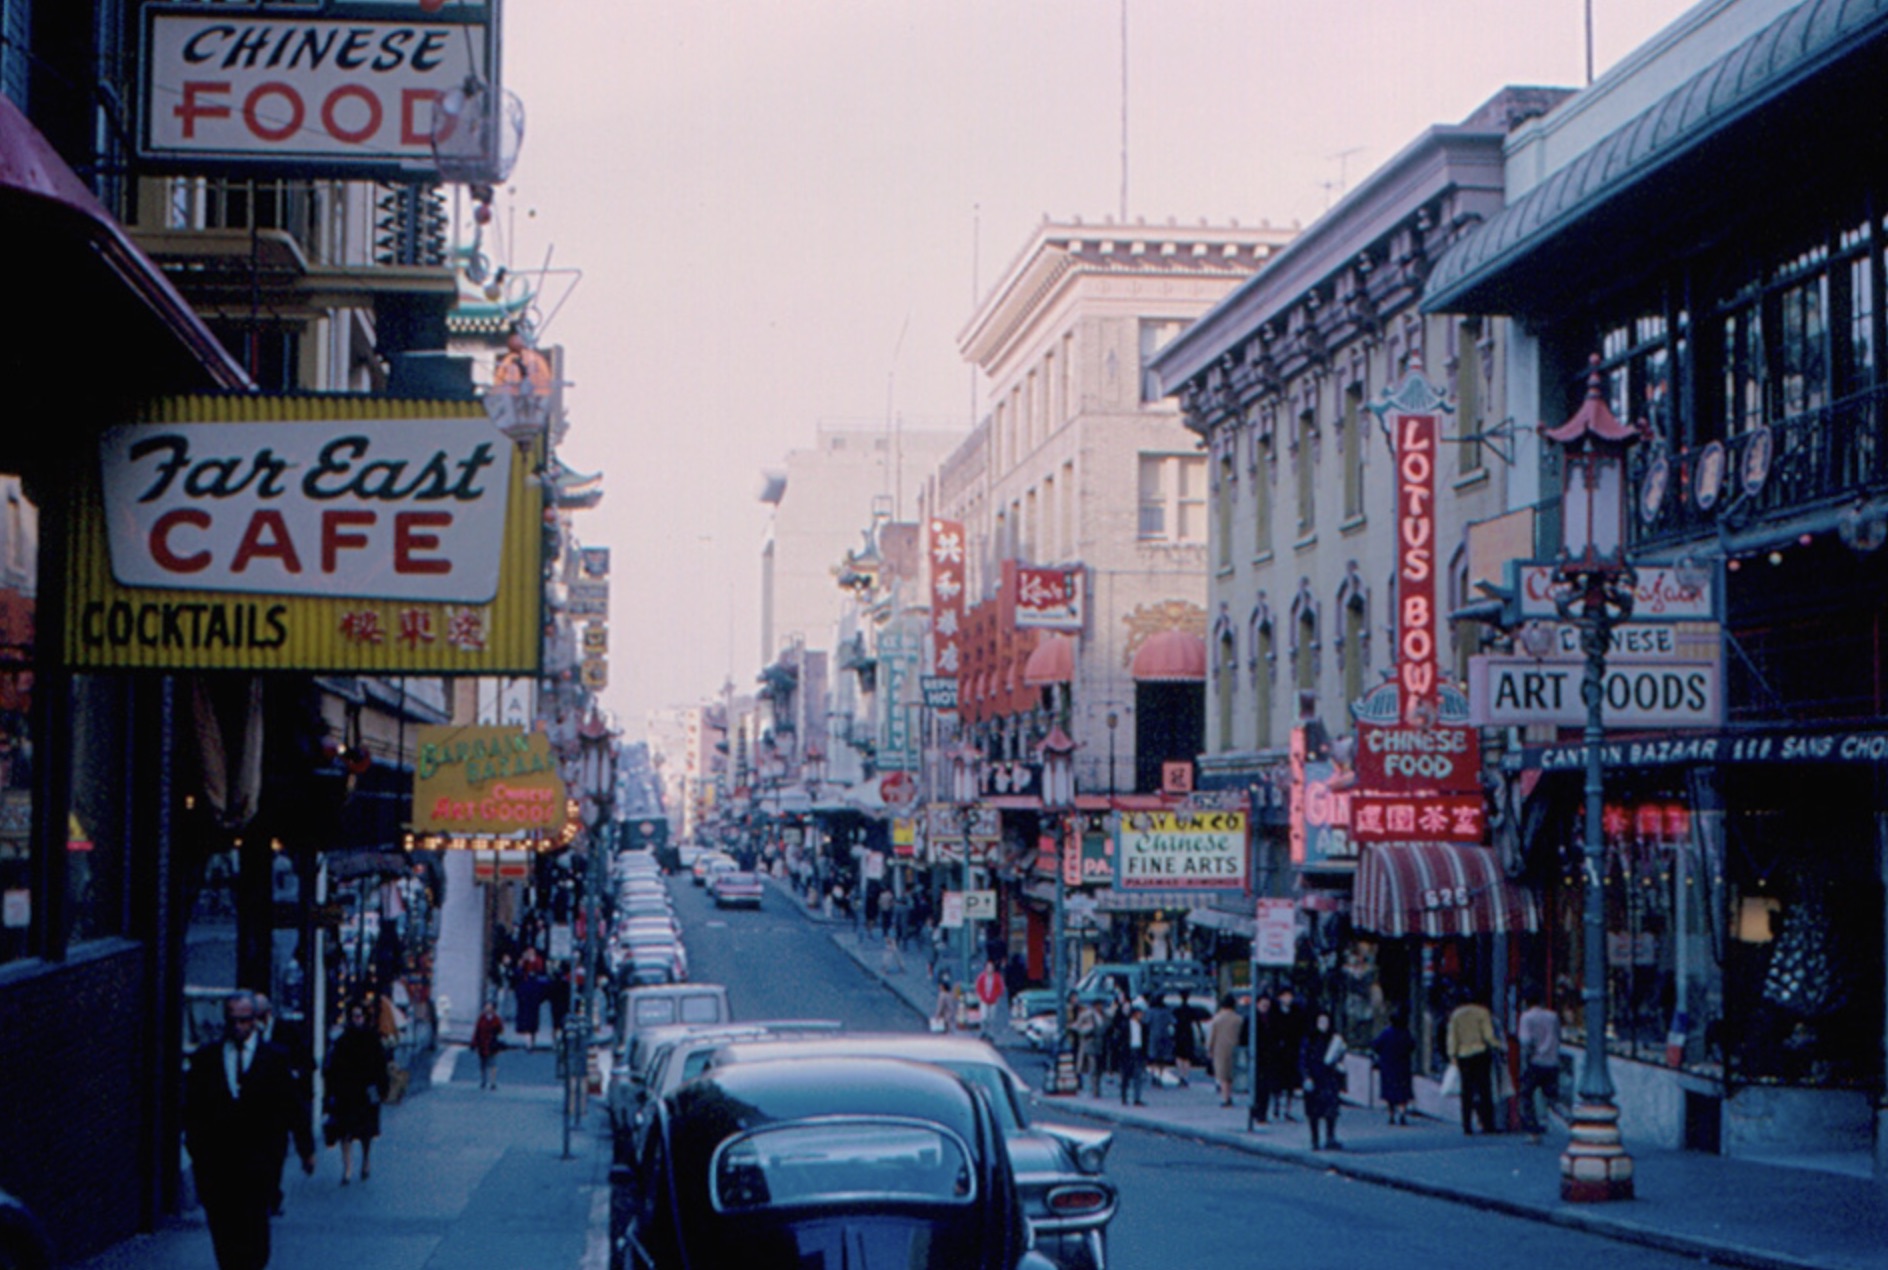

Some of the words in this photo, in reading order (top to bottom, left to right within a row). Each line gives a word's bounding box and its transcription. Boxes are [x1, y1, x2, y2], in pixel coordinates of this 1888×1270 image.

[182, 25, 451, 72] CHINESE
[173, 81, 459, 145] FOOD
[129, 433, 298, 503] Far
[301, 435, 495, 501] East
[1404, 420, 1430, 582] LOTUS
[148, 508, 453, 574] CAFE
[81, 601, 289, 649] COCKTAILS
[1496, 673, 1568, 709] ART
[419, 736, 530, 780] BARGAIN
[1367, 730, 1467, 753] CHINESE
[1629, 737, 1718, 766] BAZAAR
[1839, 734, 1888, 760] CHO
[1385, 755, 1453, 778] FOOD
[431, 797, 476, 821] ART
[1135, 833, 1230, 853] Chinese
[1128, 857, 1176, 873] FINE
[1183, 857, 1238, 873] ARTS
